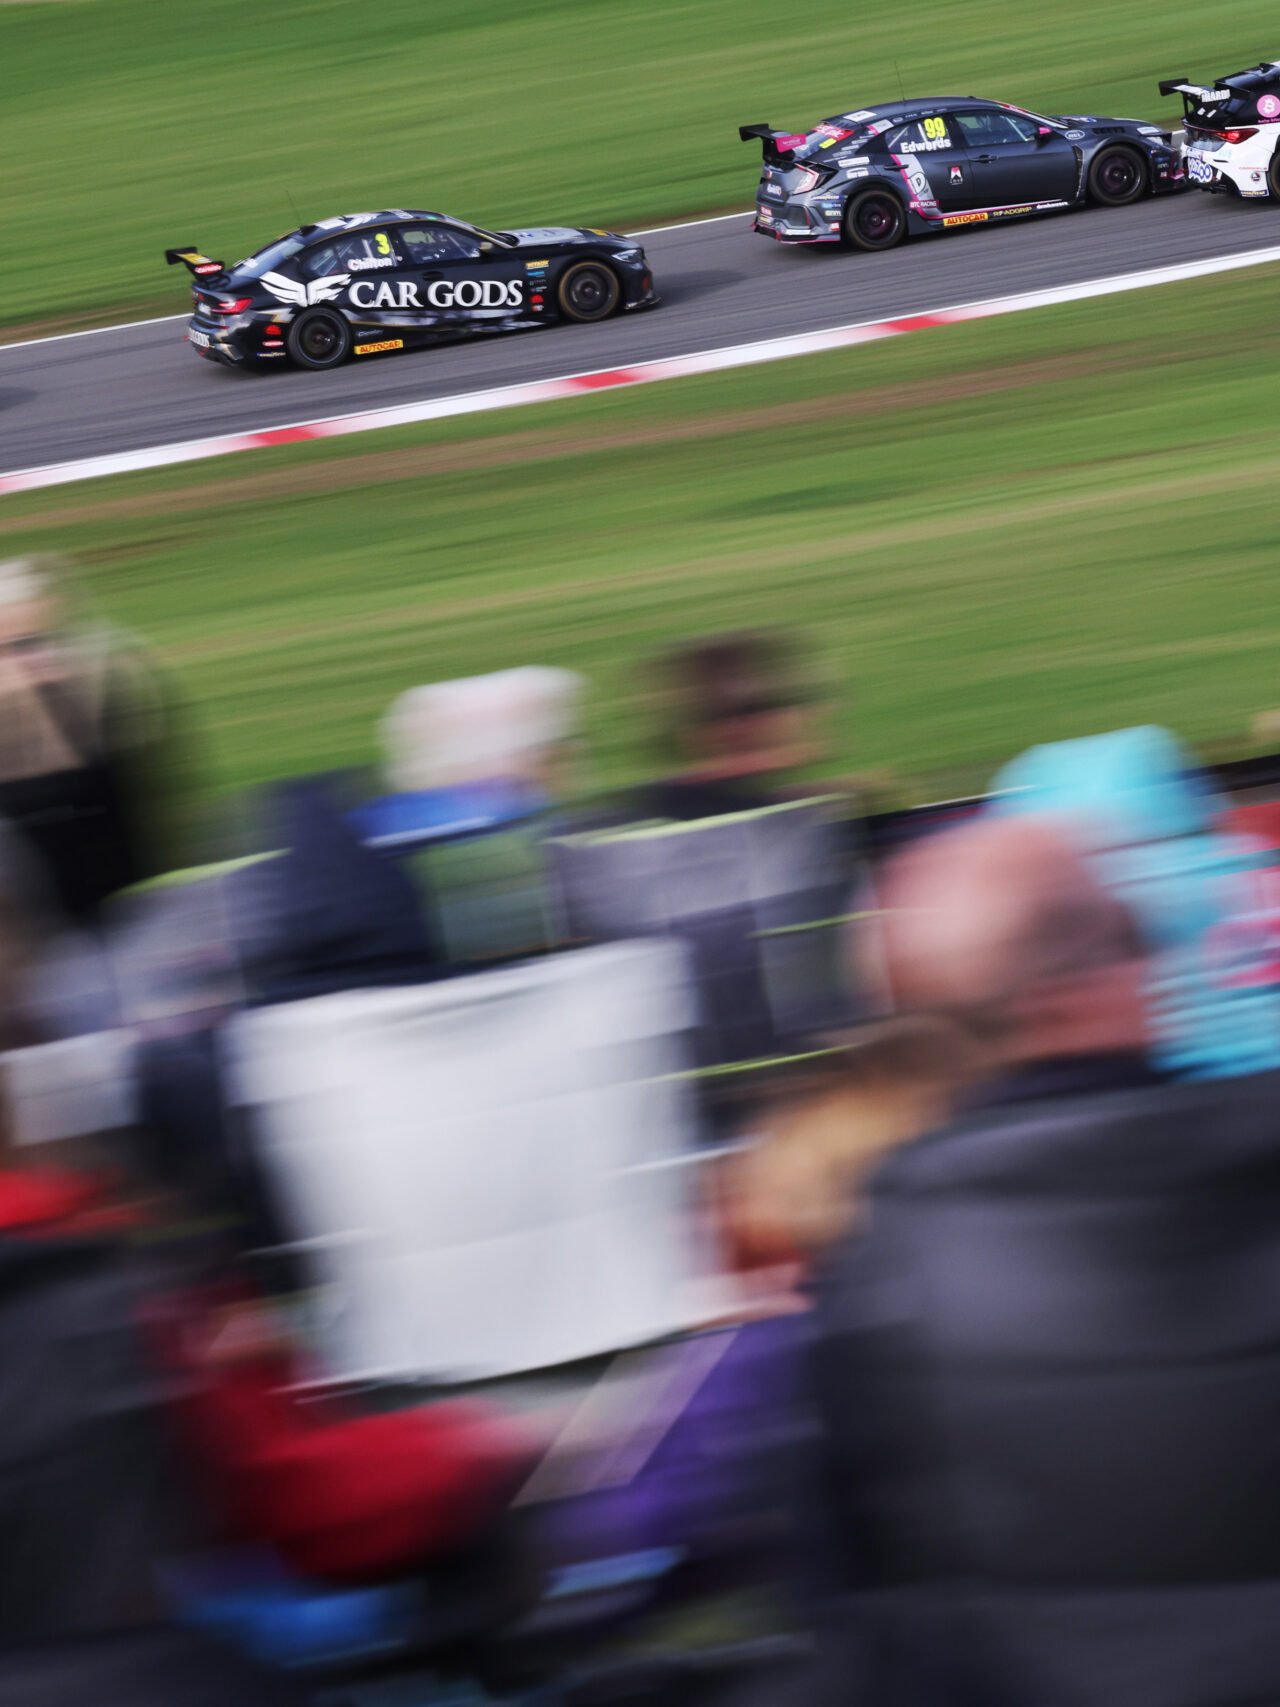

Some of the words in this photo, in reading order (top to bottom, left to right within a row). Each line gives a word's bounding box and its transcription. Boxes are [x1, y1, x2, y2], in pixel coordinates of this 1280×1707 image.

[924, 117, 946, 138] 99
[900, 138, 952, 154] Edwards
[946, 213, 986, 225] AUTOCAR
[374, 233, 391, 255] 3
[347, 256, 394, 271] Chilton
[348, 280, 425, 308] CAR
[427, 279, 524, 308] GODS
[359, 340, 401, 354] AUTOCAR
